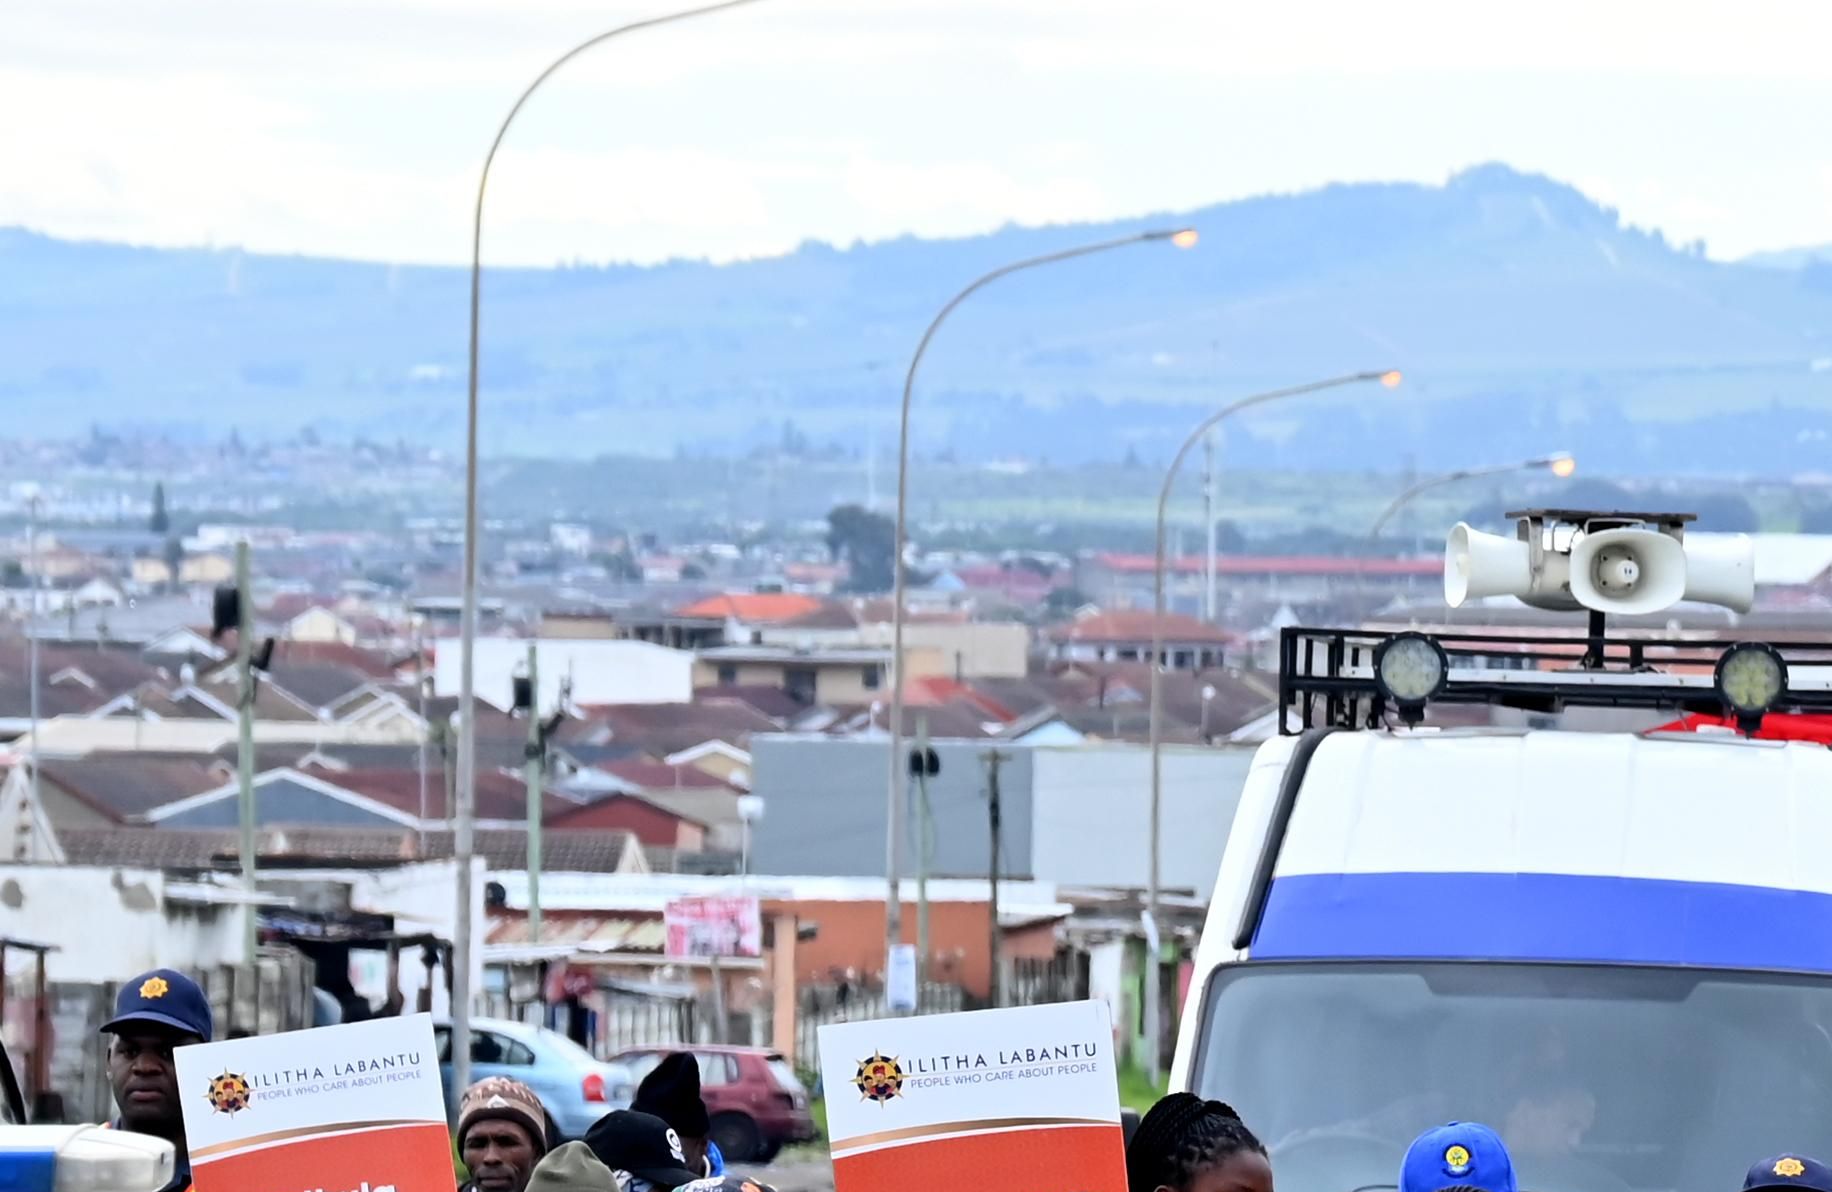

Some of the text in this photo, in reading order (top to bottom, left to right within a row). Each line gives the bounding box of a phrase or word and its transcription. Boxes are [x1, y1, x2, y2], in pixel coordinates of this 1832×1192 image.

[254, 1052, 421, 1088] ILITHA LABANTU
[908, 1042, 1097, 1073] ILITHA LABANTU
[257, 1069, 421, 1101] PEOPLE WHO CARE ABOUT PEOPLE
[910, 1062, 1097, 1089] PEOPLE WHO CARE ABOUT PEOPLE
